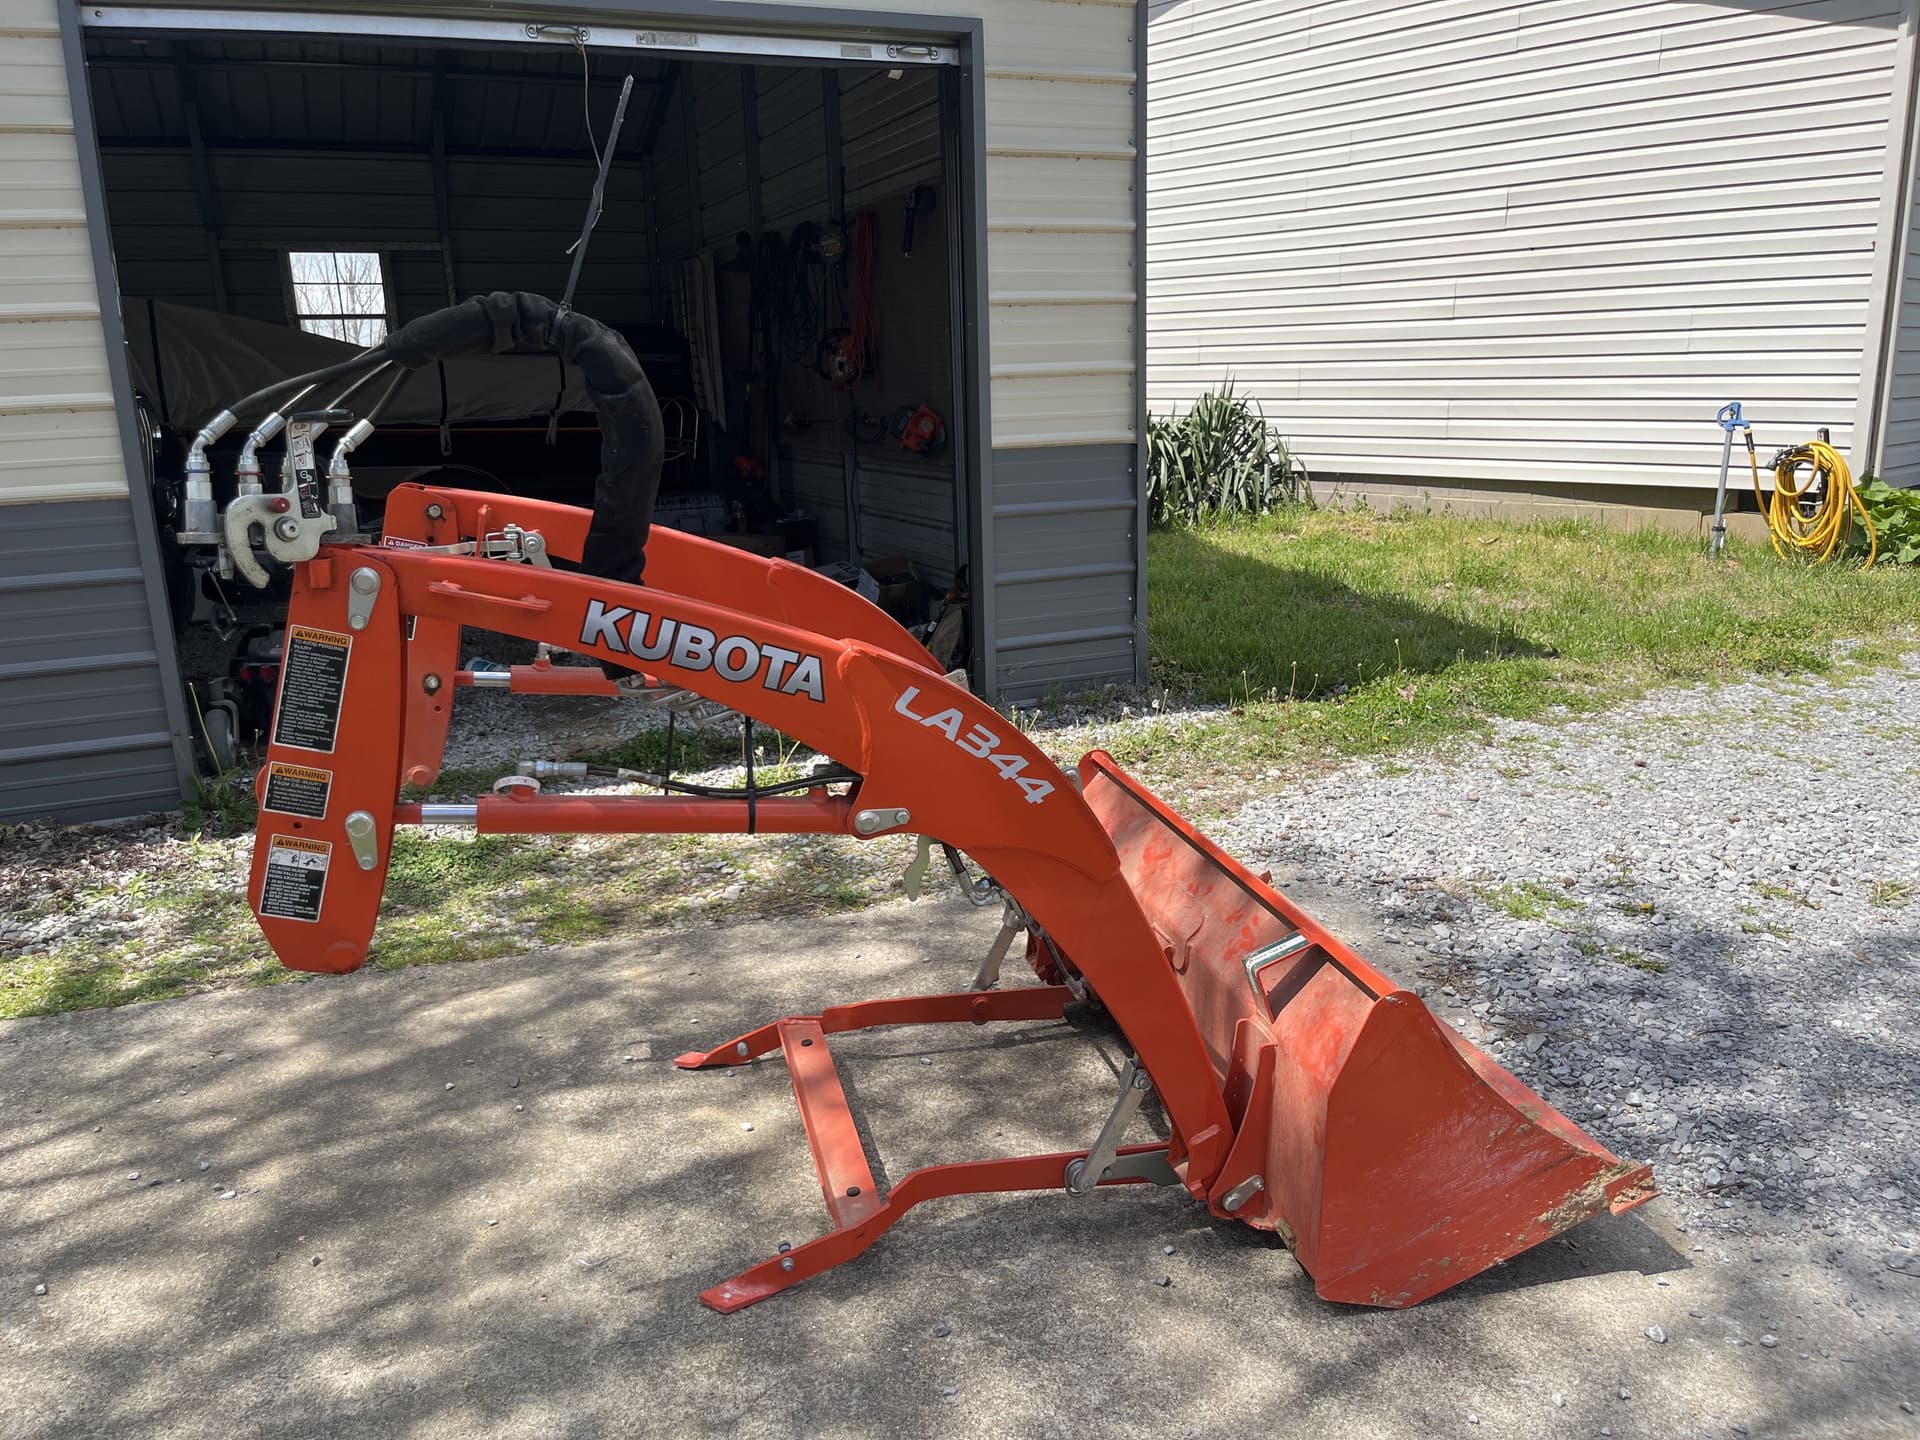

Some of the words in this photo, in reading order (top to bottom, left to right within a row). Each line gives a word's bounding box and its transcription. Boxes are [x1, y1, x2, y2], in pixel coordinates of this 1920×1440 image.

[304, 631, 347, 645] WARNING
[579, 598, 825, 704] KUBOTA
[894, 685, 1056, 805] LA344
[284, 767, 327, 781] WARNING
[284, 839, 327, 852] WARNING
